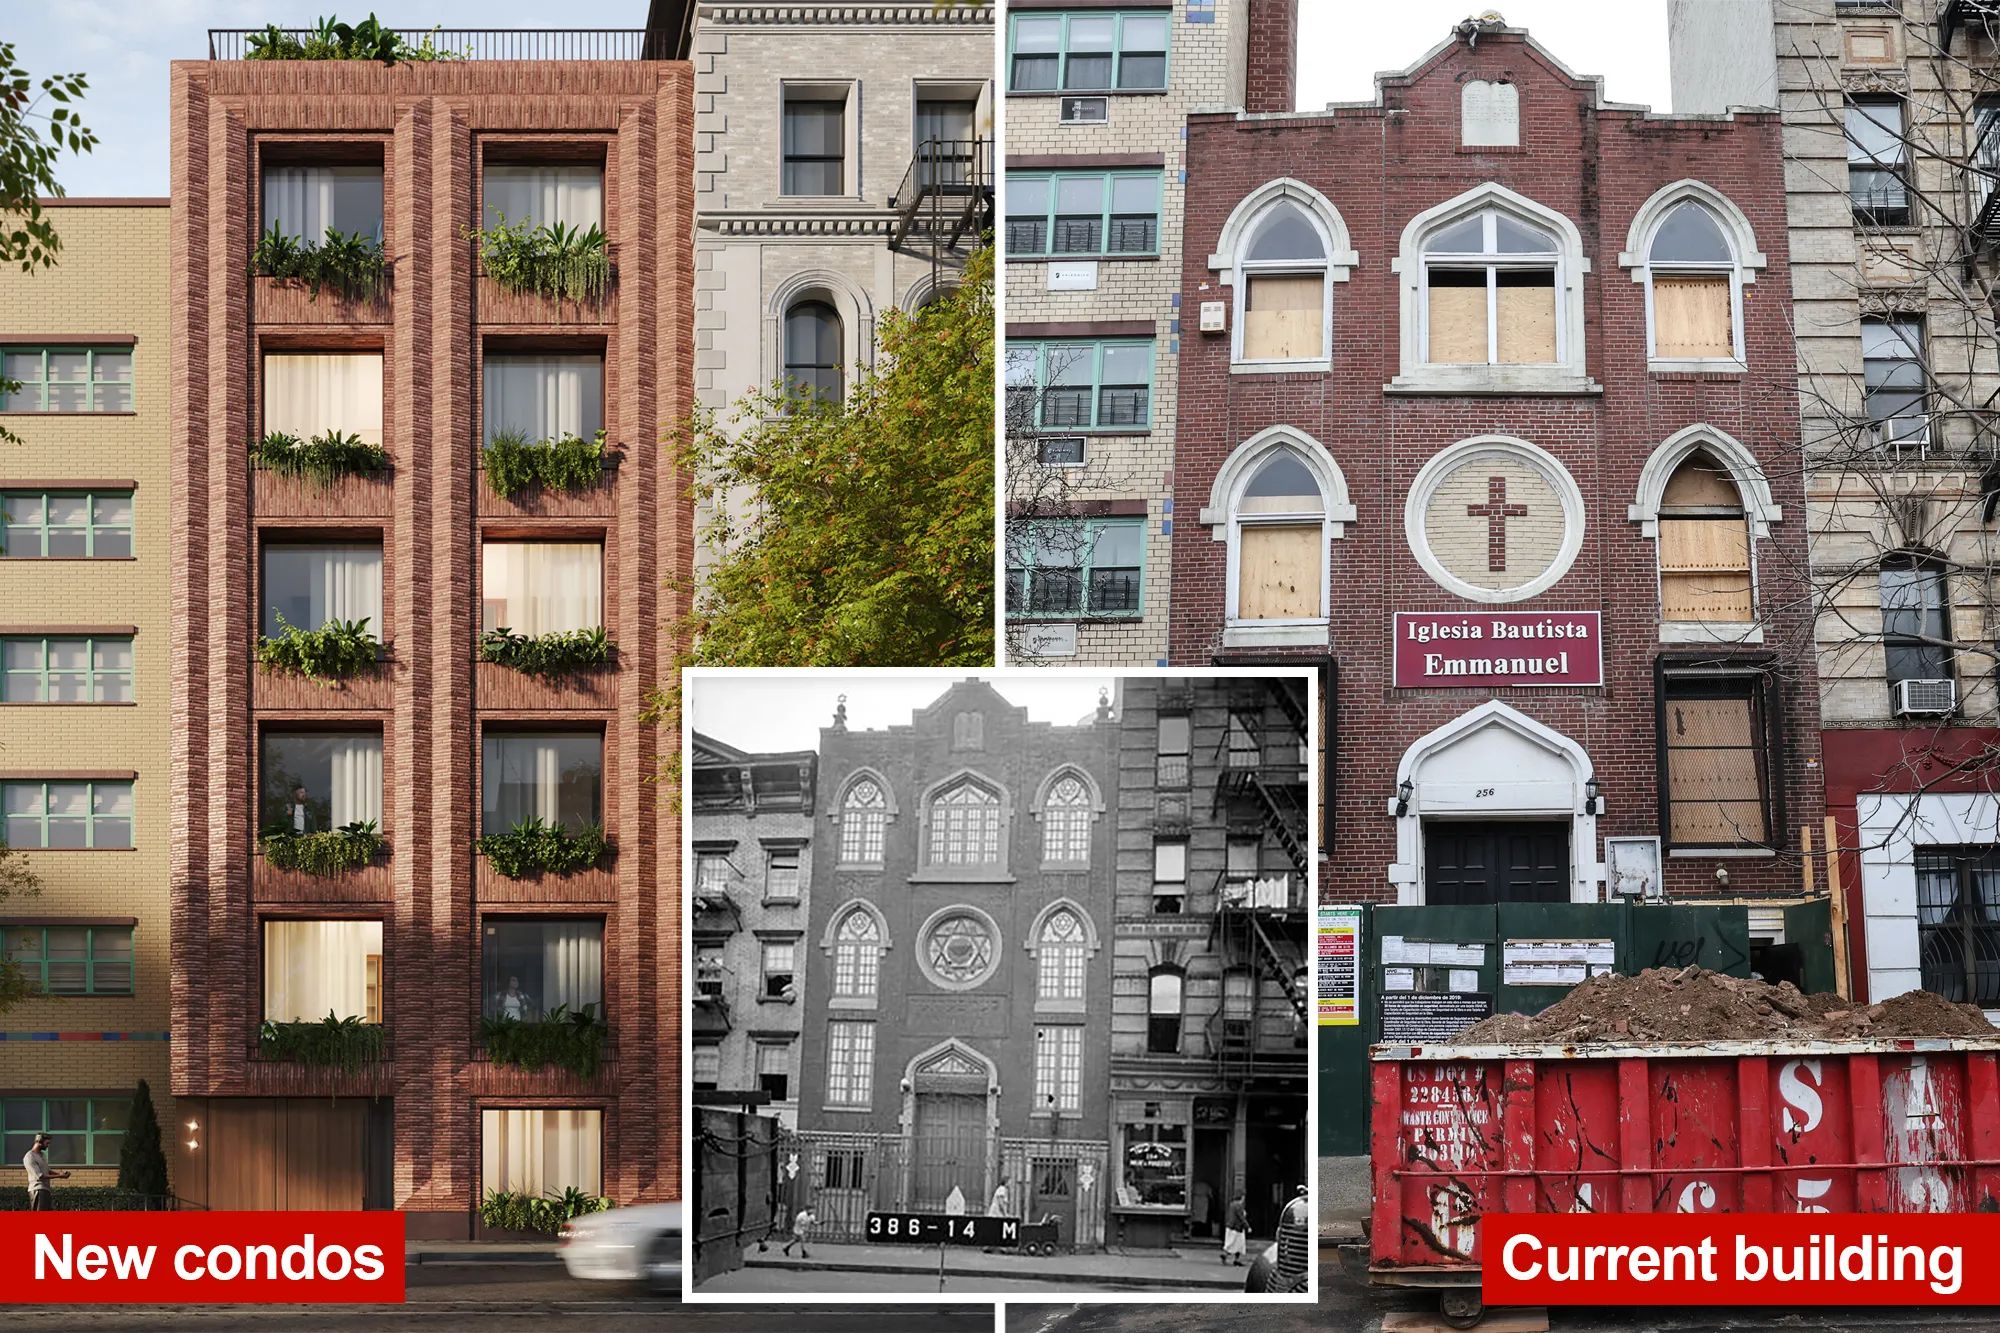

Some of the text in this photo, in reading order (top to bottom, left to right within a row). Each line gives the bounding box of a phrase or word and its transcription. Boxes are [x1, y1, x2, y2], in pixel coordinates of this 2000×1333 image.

[1407, 619, 1588, 642] Iglesia Bautista
[1423, 652, 1569, 676] Emmanuel
[1476, 788, 1495, 798] 256
[870, 1217, 1017, 1240] 386-14 M
